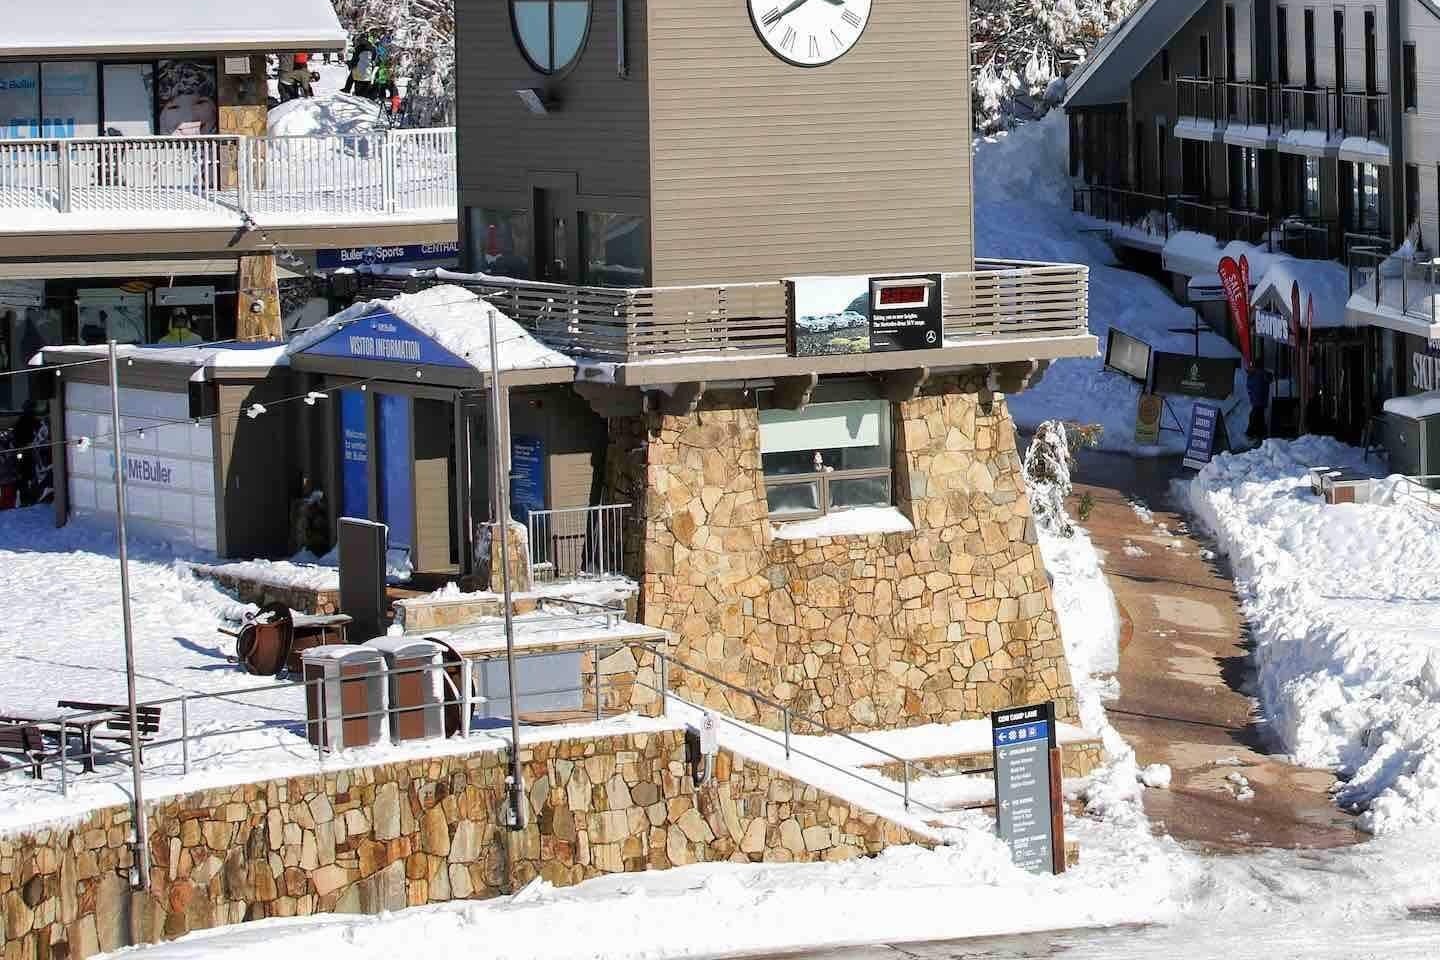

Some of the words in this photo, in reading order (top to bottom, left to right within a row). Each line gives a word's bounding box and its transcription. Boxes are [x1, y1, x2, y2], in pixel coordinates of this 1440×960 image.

[341, 249, 363, 261] Buller
[376, 247, 404, 261] Sports
[350, 336, 374, 355] VISITOR
[375, 338, 421, 360] INFORMATION
